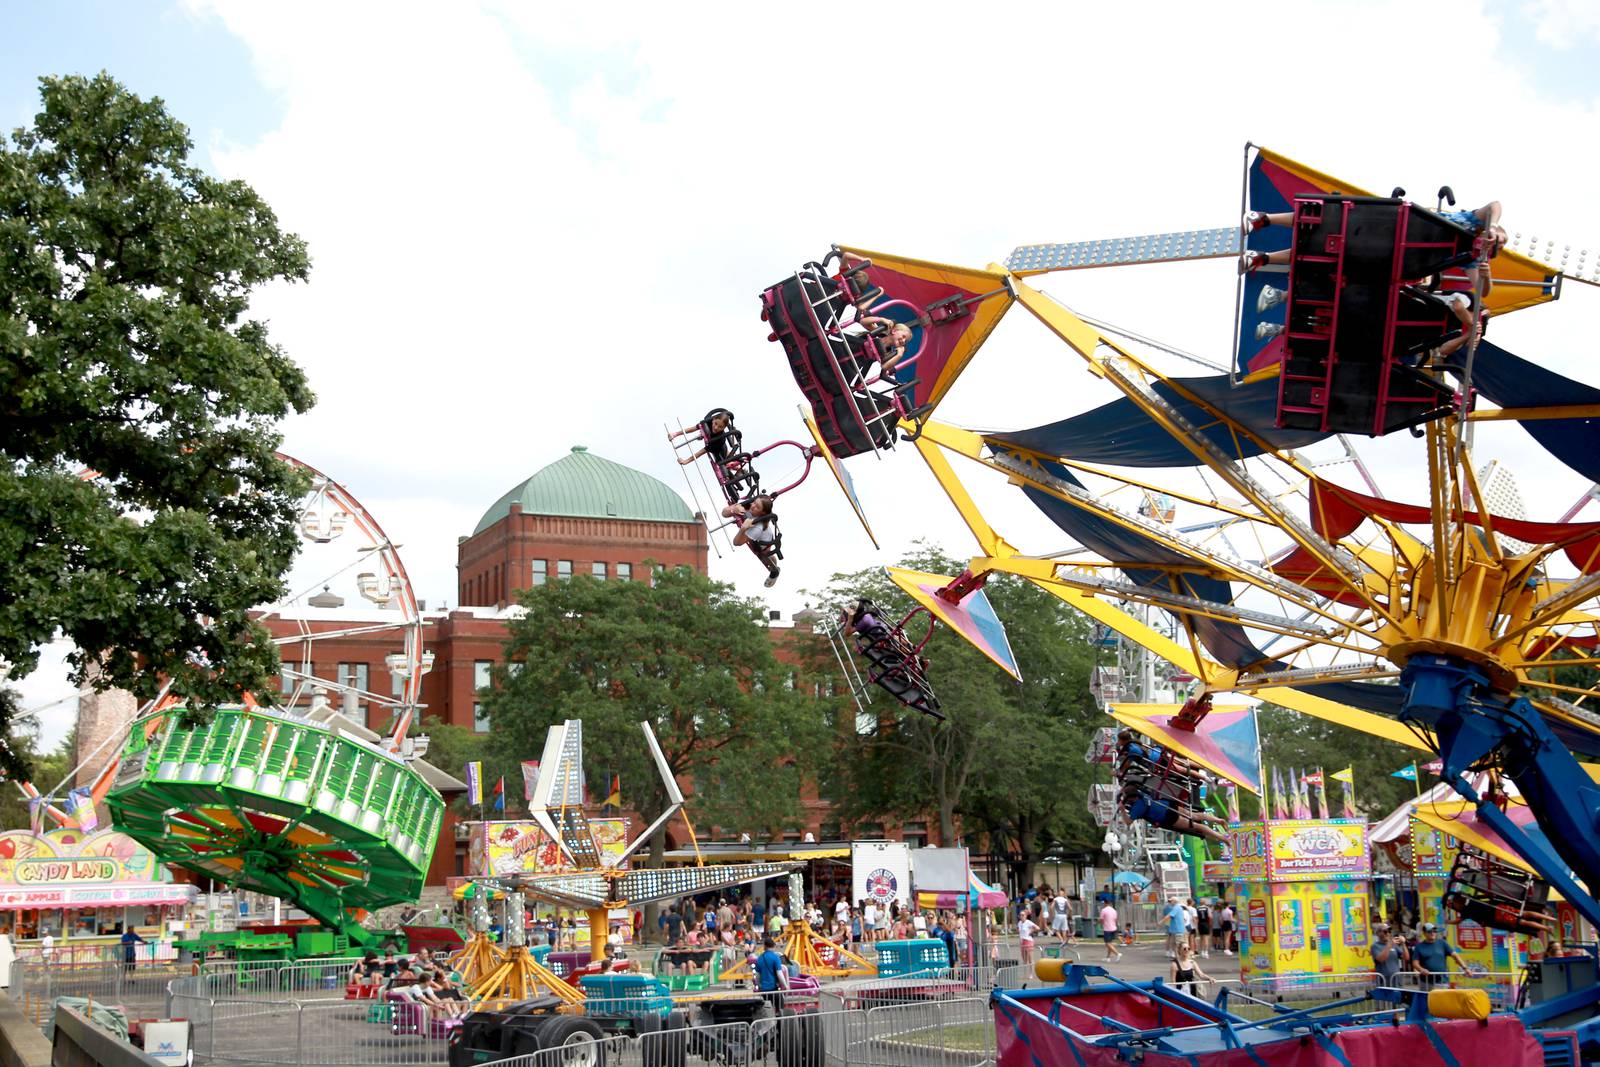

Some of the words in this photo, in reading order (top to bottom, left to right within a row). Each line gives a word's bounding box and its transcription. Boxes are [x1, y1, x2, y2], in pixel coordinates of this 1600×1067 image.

[1301, 839, 1339, 851] WCA
[1323, 858, 1342, 867] Family
[19, 863, 69, 881] CANDY
[71, 861, 113, 879] LAND
